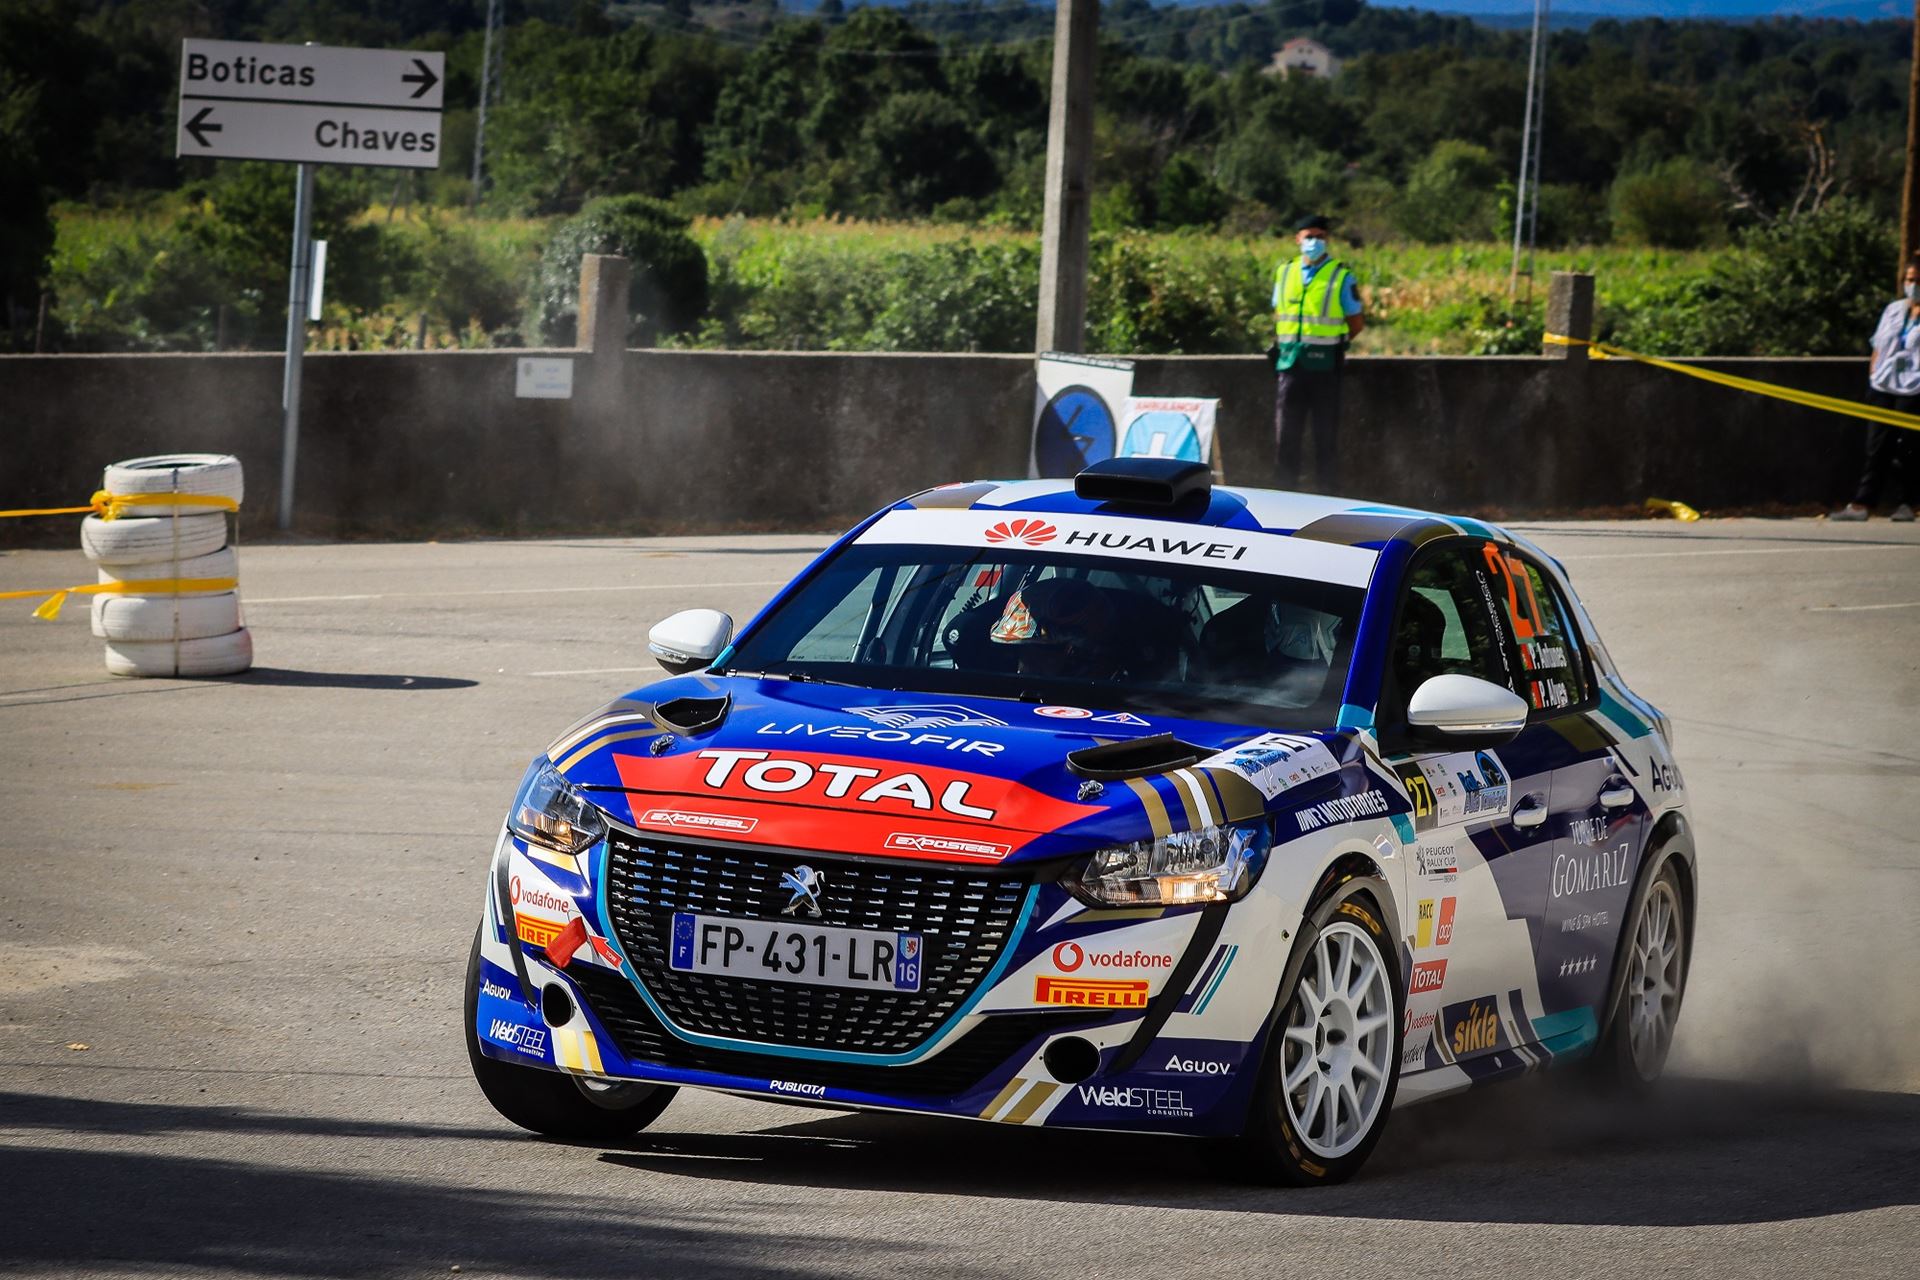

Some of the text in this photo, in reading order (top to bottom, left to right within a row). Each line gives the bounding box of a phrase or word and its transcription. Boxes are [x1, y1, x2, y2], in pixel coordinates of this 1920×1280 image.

[187, 54, 315, 87] Boticas
[315, 120, 436, 152] Chaves
[1065, 531, 1247, 560] HUAWEI
[1482, 541, 1544, 638] 27
[757, 723, 1005, 757] LIVEOFIR
[698, 751, 996, 821] TOTAL
[1405, 776, 1432, 817] 27
[1317, 789, 1389, 823] MOTOTORRES
[651, 813, 748, 829] EXPOSTEEL
[1595, 816, 1608, 841] DE
[896, 836, 1002, 855] EXPOSTEEL
[1425, 846, 1454, 856] PEUGEOT
[1427, 857, 1456, 867] RALLY CUP
[1552, 842, 1629, 898] GOMARIZ
[522, 890, 570, 913] vodafone
[1419, 903, 1434, 920] RACC
[679, 946, 687, 957] F
[701, 924, 894, 982] FP-431-LR
[1089, 950, 1172, 968] vodafone
[899, 963, 917, 982] 16
[1414, 967, 1442, 988] TOTAL
[1036, 977, 1149, 1006] PIRELLI
[1454, 1001, 1498, 1055] sikla
[1147, 1109, 1194, 1117] consulting
